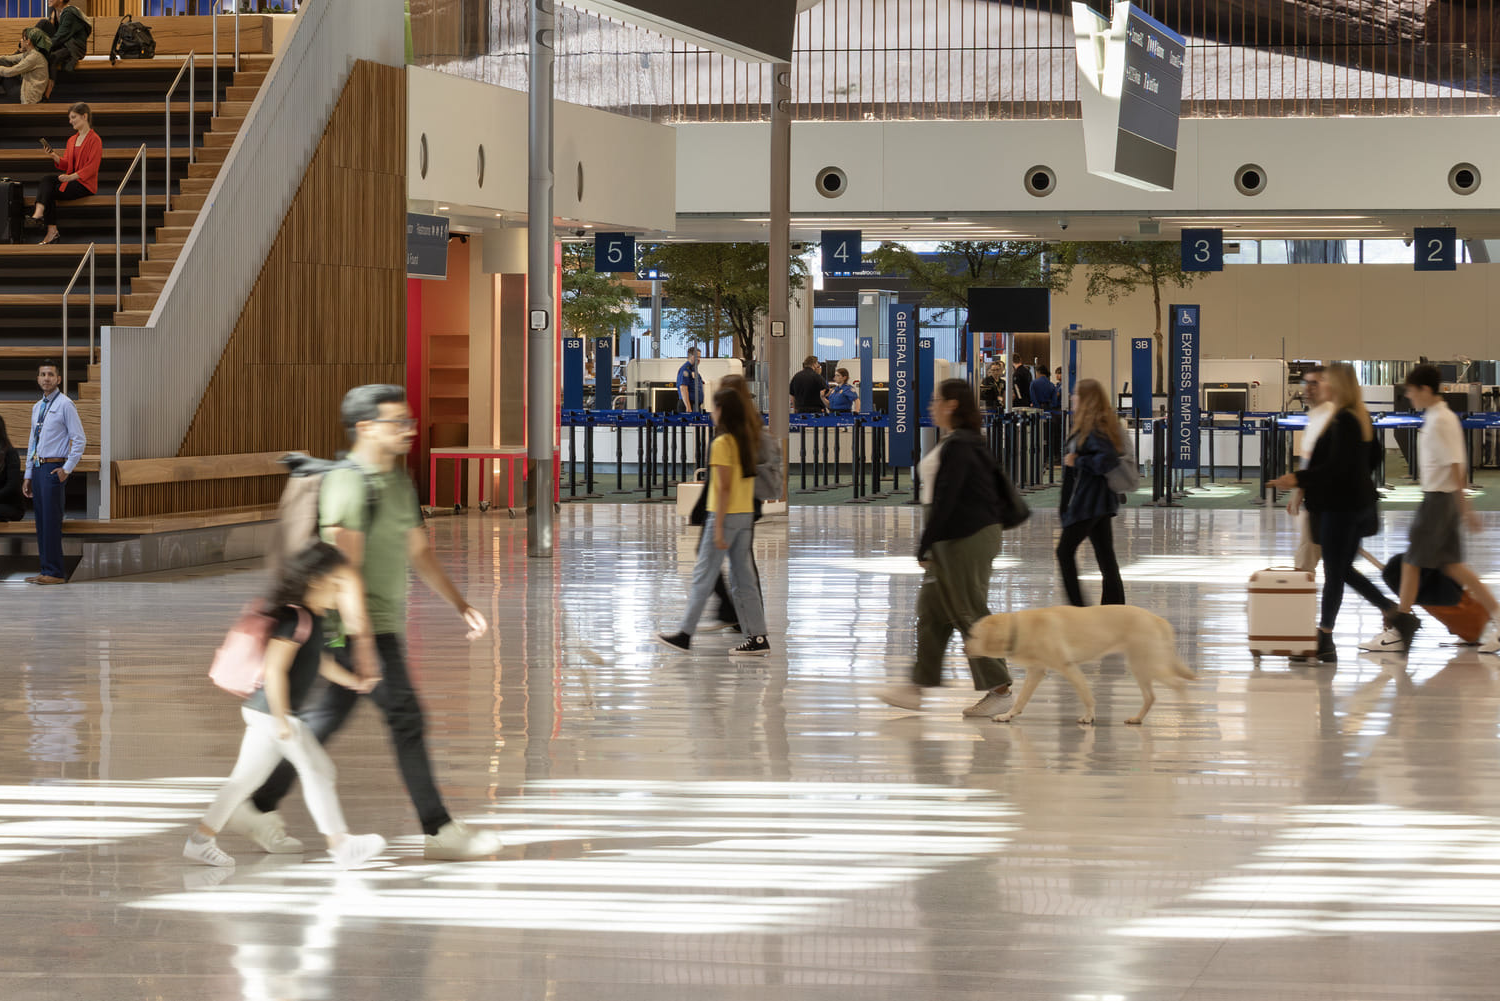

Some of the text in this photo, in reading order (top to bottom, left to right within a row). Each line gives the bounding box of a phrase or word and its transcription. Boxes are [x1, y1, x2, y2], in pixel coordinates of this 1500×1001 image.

[607, 241, 623, 263] 5
[833, 241, 849, 263] 4
[1194, 239, 1211, 263] 3
[1427, 239, 1444, 262] 2
[567, 340, 580, 349] 5B
[598, 340, 609, 348] 5A
[862, 340, 870, 348] 4A
[919, 340, 931, 349] 4B
[1135, 340, 1149, 349] 3B
[896, 311, 907, 433] GENERAL BOARDING
[1180, 333, 1192, 461] EXPRESS, EMPLOYEE
